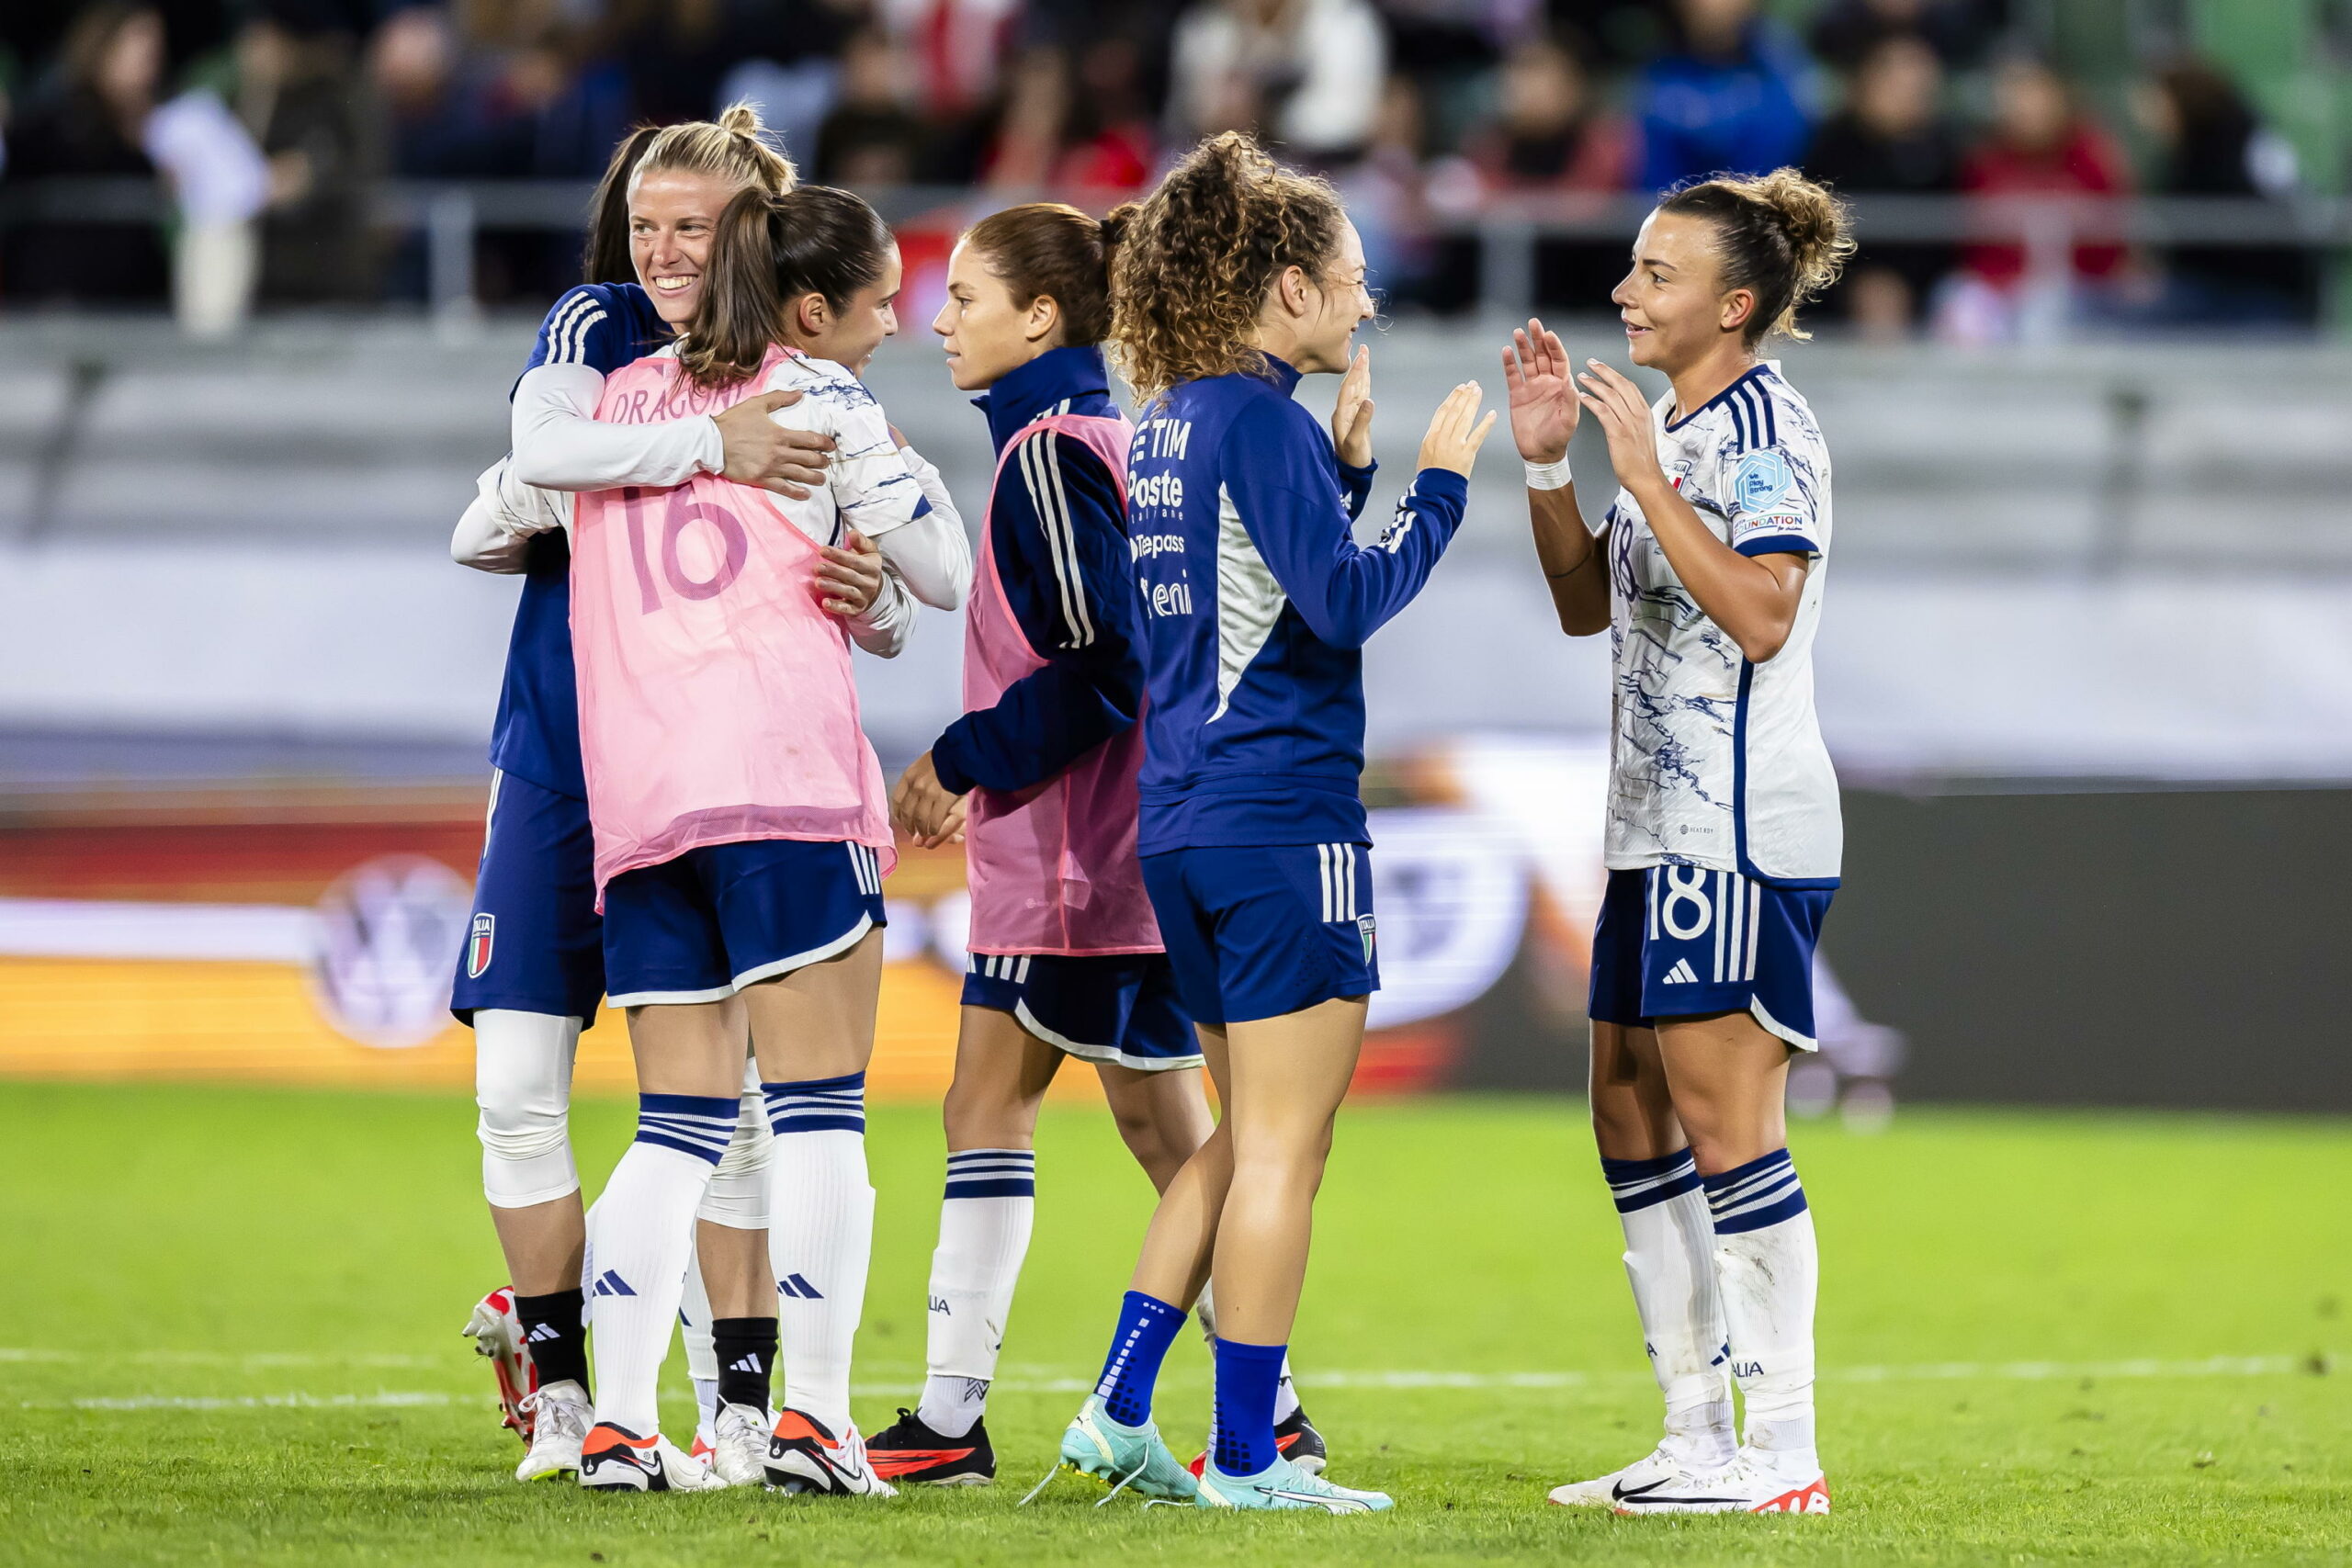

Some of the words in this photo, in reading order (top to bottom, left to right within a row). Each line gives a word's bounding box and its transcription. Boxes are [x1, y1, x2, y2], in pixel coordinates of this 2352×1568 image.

[1152, 419, 1192, 460] TIM
[1128, 469, 1183, 509] Poste
[1734, 515, 1803, 536] FOUNDATION
[623, 486, 748, 615] 16
[1611, 514, 1637, 603] 18
[1153, 569, 1193, 617] eni
[1650, 864, 1713, 940] 18
[1732, 1361, 1764, 1378] ALIA
